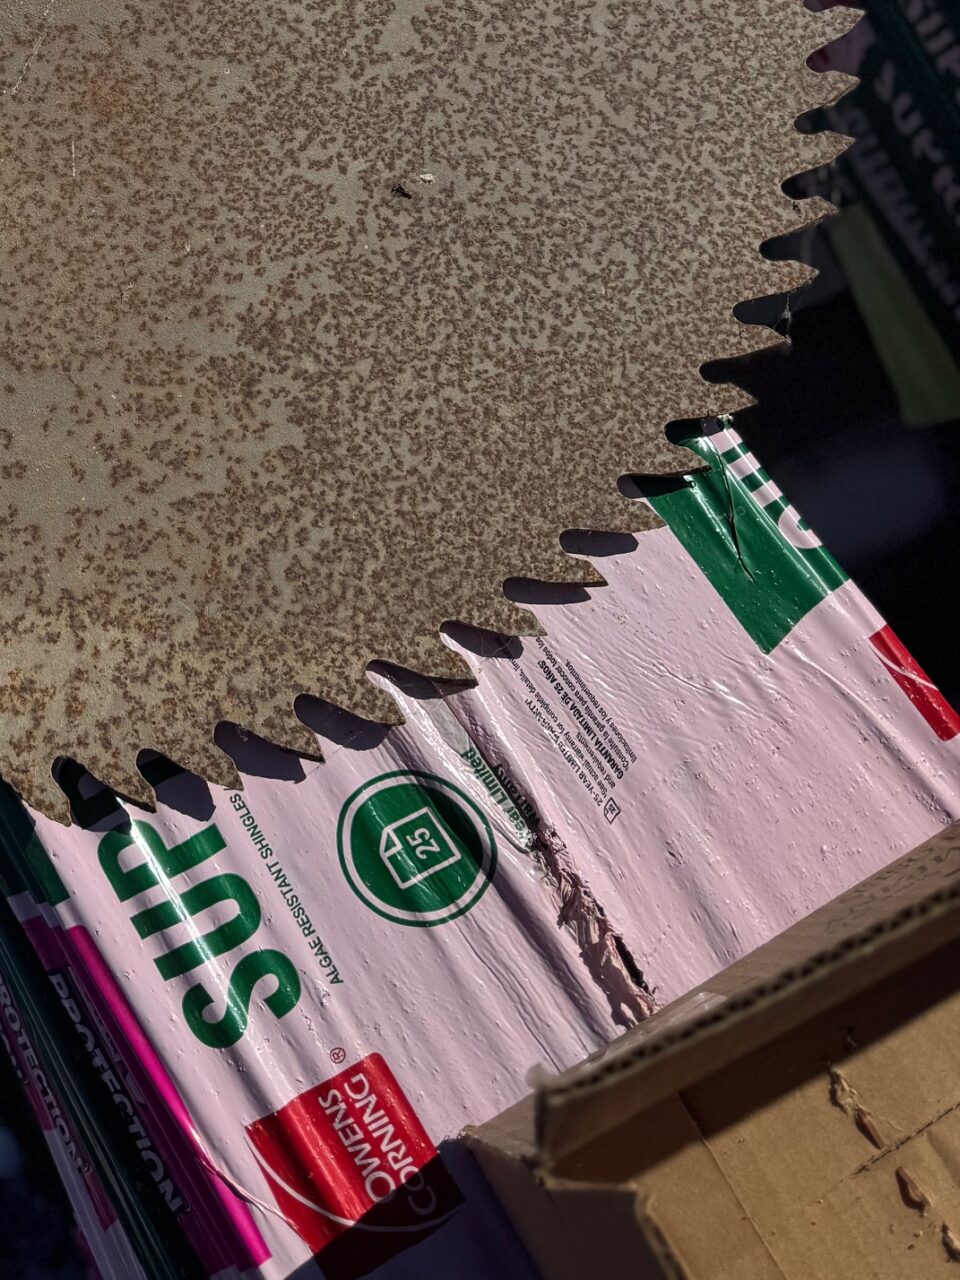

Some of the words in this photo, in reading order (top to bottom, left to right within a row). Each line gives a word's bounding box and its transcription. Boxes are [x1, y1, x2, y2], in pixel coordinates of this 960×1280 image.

[532, 635, 545, 649] los
[540, 645, 559, 668] todos
[552, 681, 565, 695] 25
[553, 663, 577, 693] conocer
[532, 689, 561, 725] complete
[558, 690, 573, 706] DE
[572, 688, 589, 707] para
[595, 705, 609, 721] los
[554, 721, 566, 734] for
[568, 702, 598, 741] LIMITADA
[581, 702, 607, 733] garantía
[561, 729, 587, 762] warranty
[599, 729, 611, 740] la
[605, 720, 639, 763] limitaciones
[580, 758, 600, 782] actual
[590, 736, 625, 781] GARANTÍA
[576, 770, 605, 806] 25-YEAR
[602, 773, 616, 789] and
[227, 790, 274, 861] SHINGLES
[501, 804, 531, 839] ear
[405, 823, 441, 862] 25
[264, 857, 317, 938] RESISTANT
[307, 935, 344, 988] ALGAE
[318, 1087, 398, 1205] OWENS
[341, 1071, 439, 1217] CORNING
